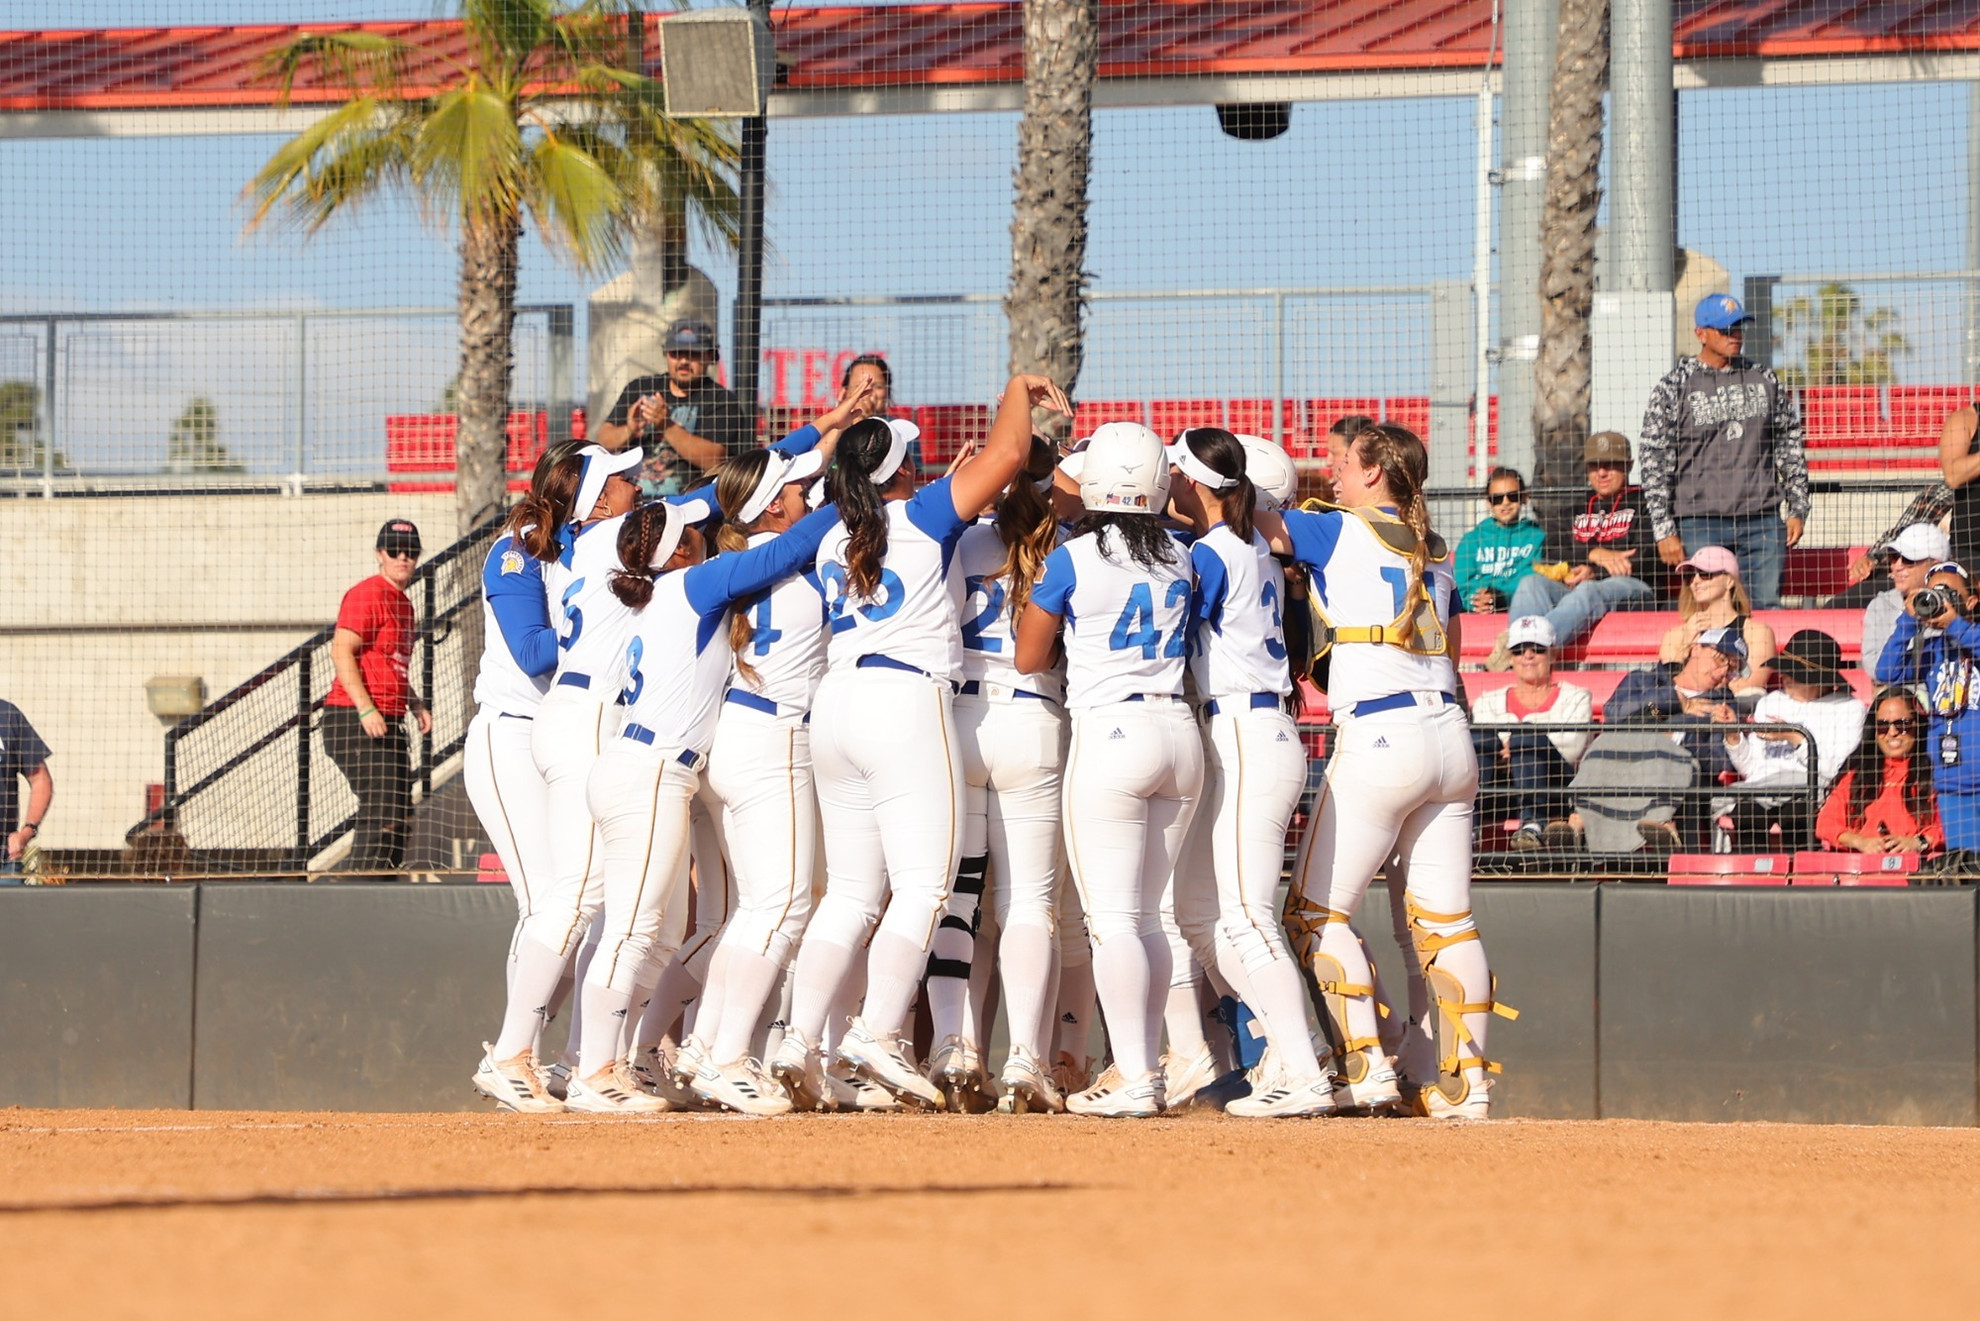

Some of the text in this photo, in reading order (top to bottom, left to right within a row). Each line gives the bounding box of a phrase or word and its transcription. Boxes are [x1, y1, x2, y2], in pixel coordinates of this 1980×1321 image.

[1122, 496, 1132, 506] 42
[962, 574, 1017, 653] 2
[1109, 579, 1190, 660] 42
[1260, 580, 1288, 660] 3
[1380, 566, 1437, 621] 1
